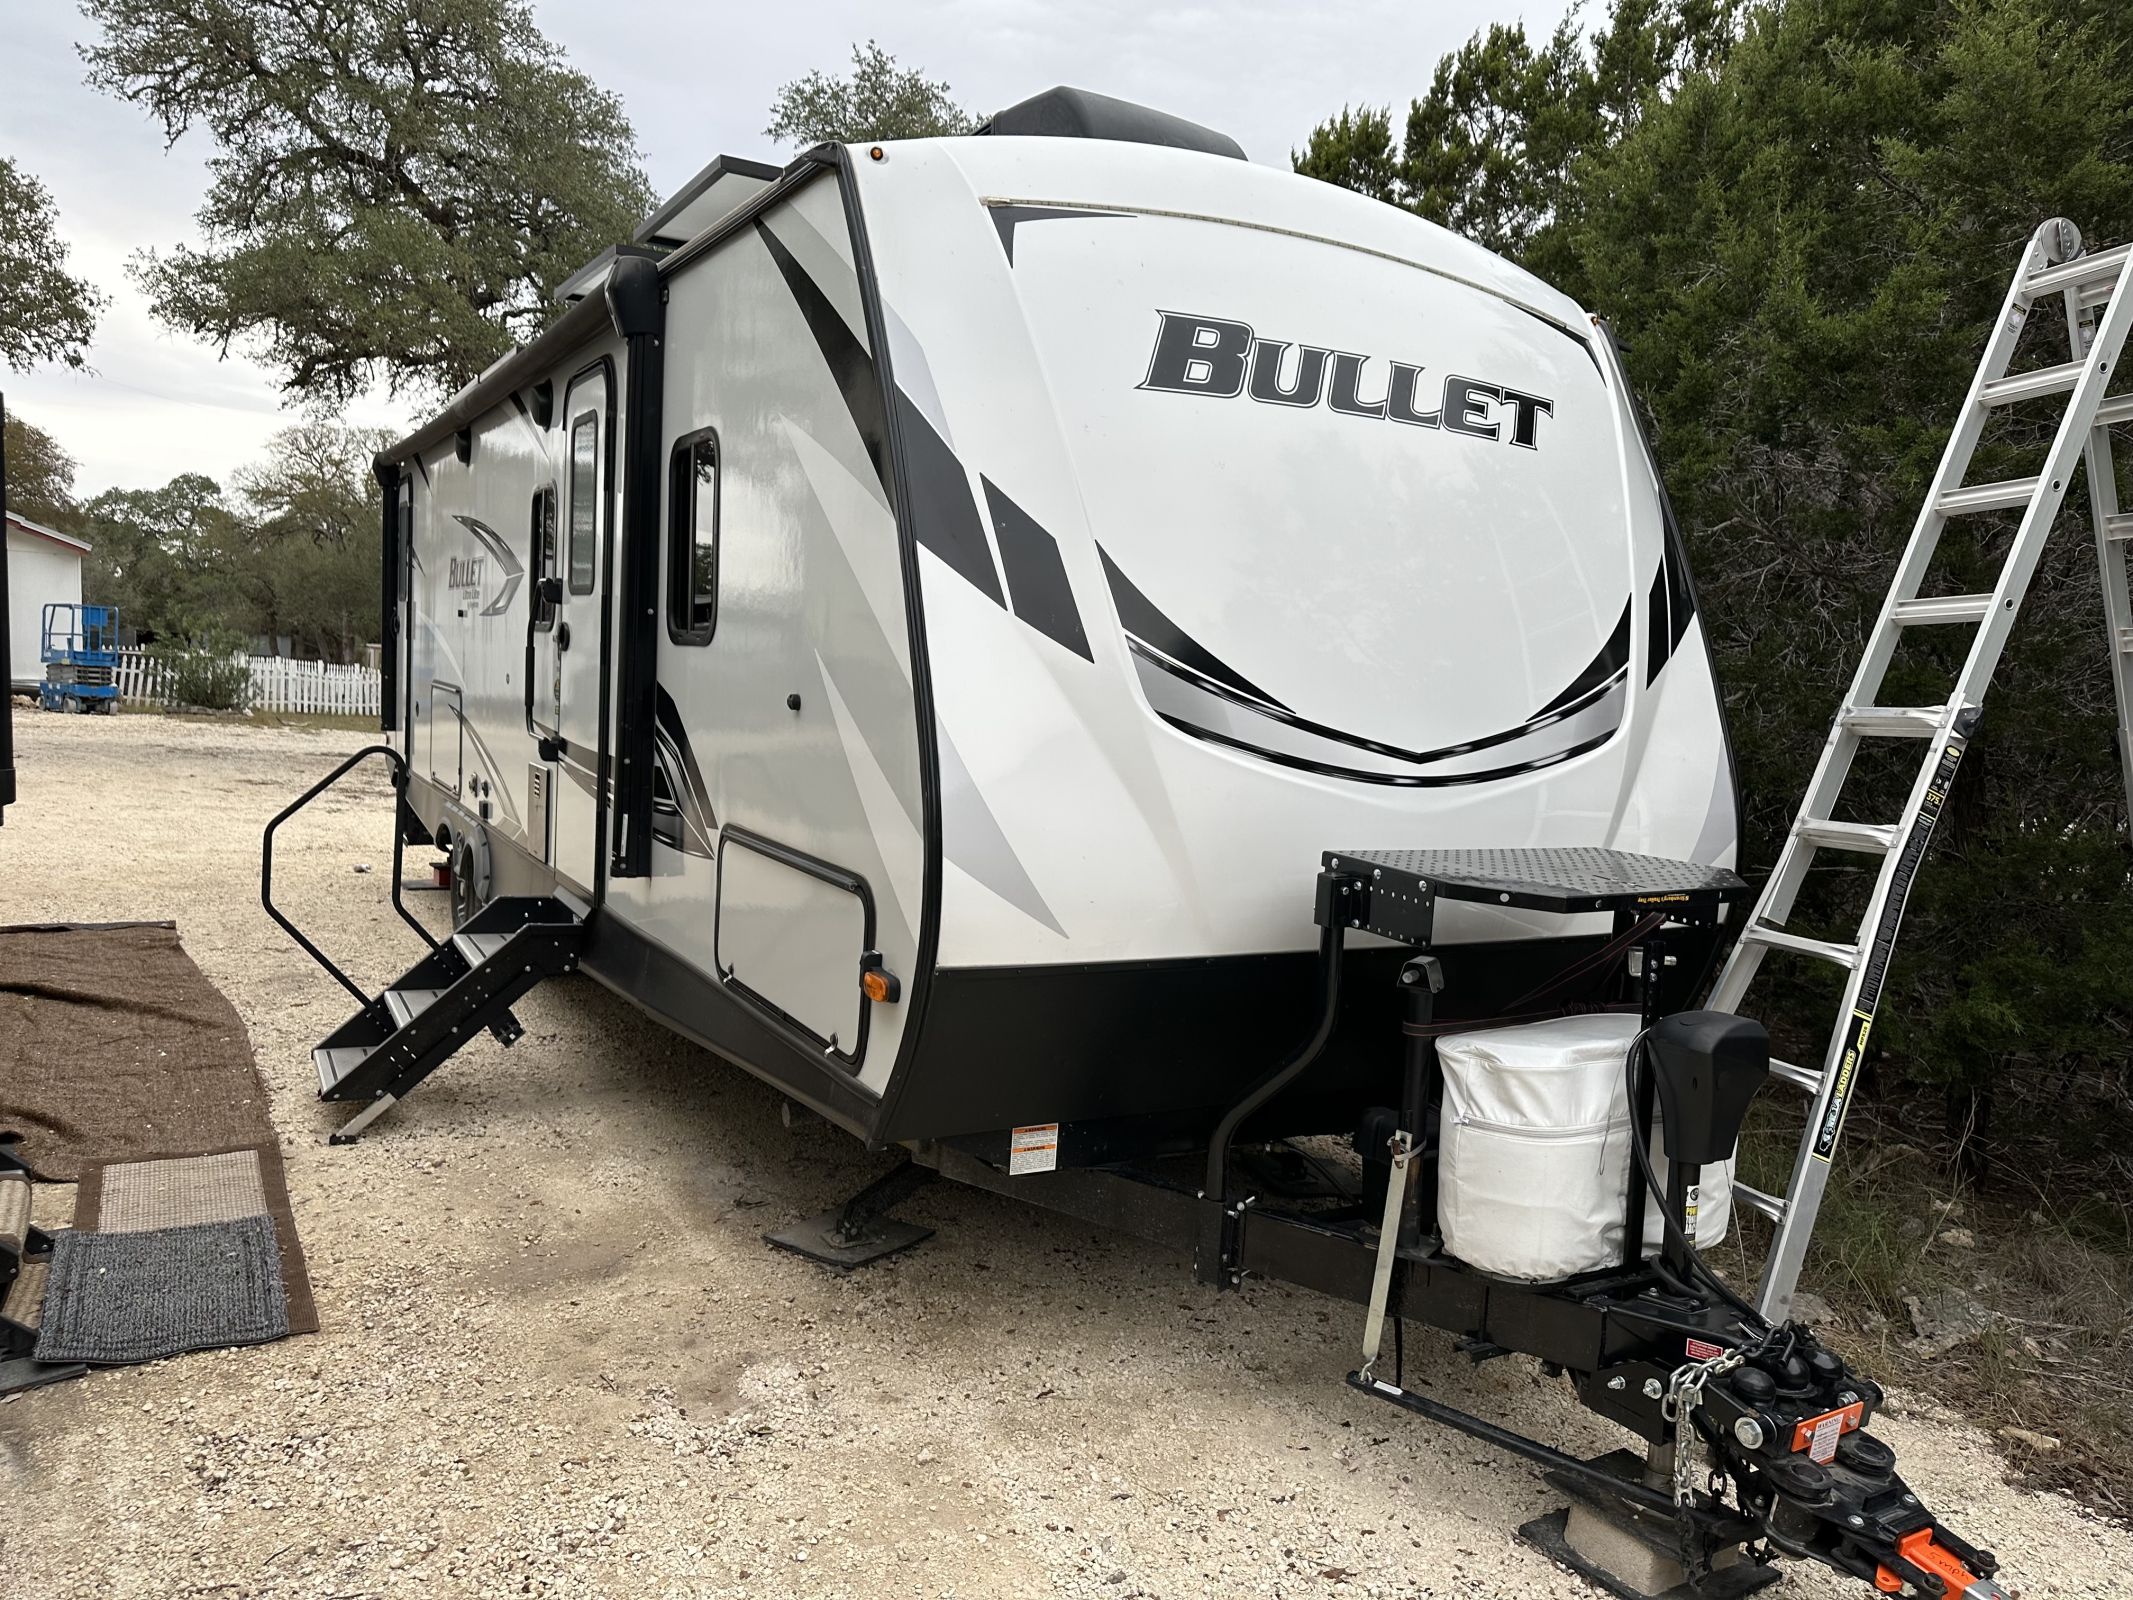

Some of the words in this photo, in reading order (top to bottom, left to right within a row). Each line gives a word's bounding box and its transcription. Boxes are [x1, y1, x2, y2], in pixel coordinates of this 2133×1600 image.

[1134, 309, 1553, 450] BULLET
[448, 557, 484, 590] BULLET
[1926, 793, 1939, 804] 375
[1835, 1050, 1856, 1099] LADDERS
